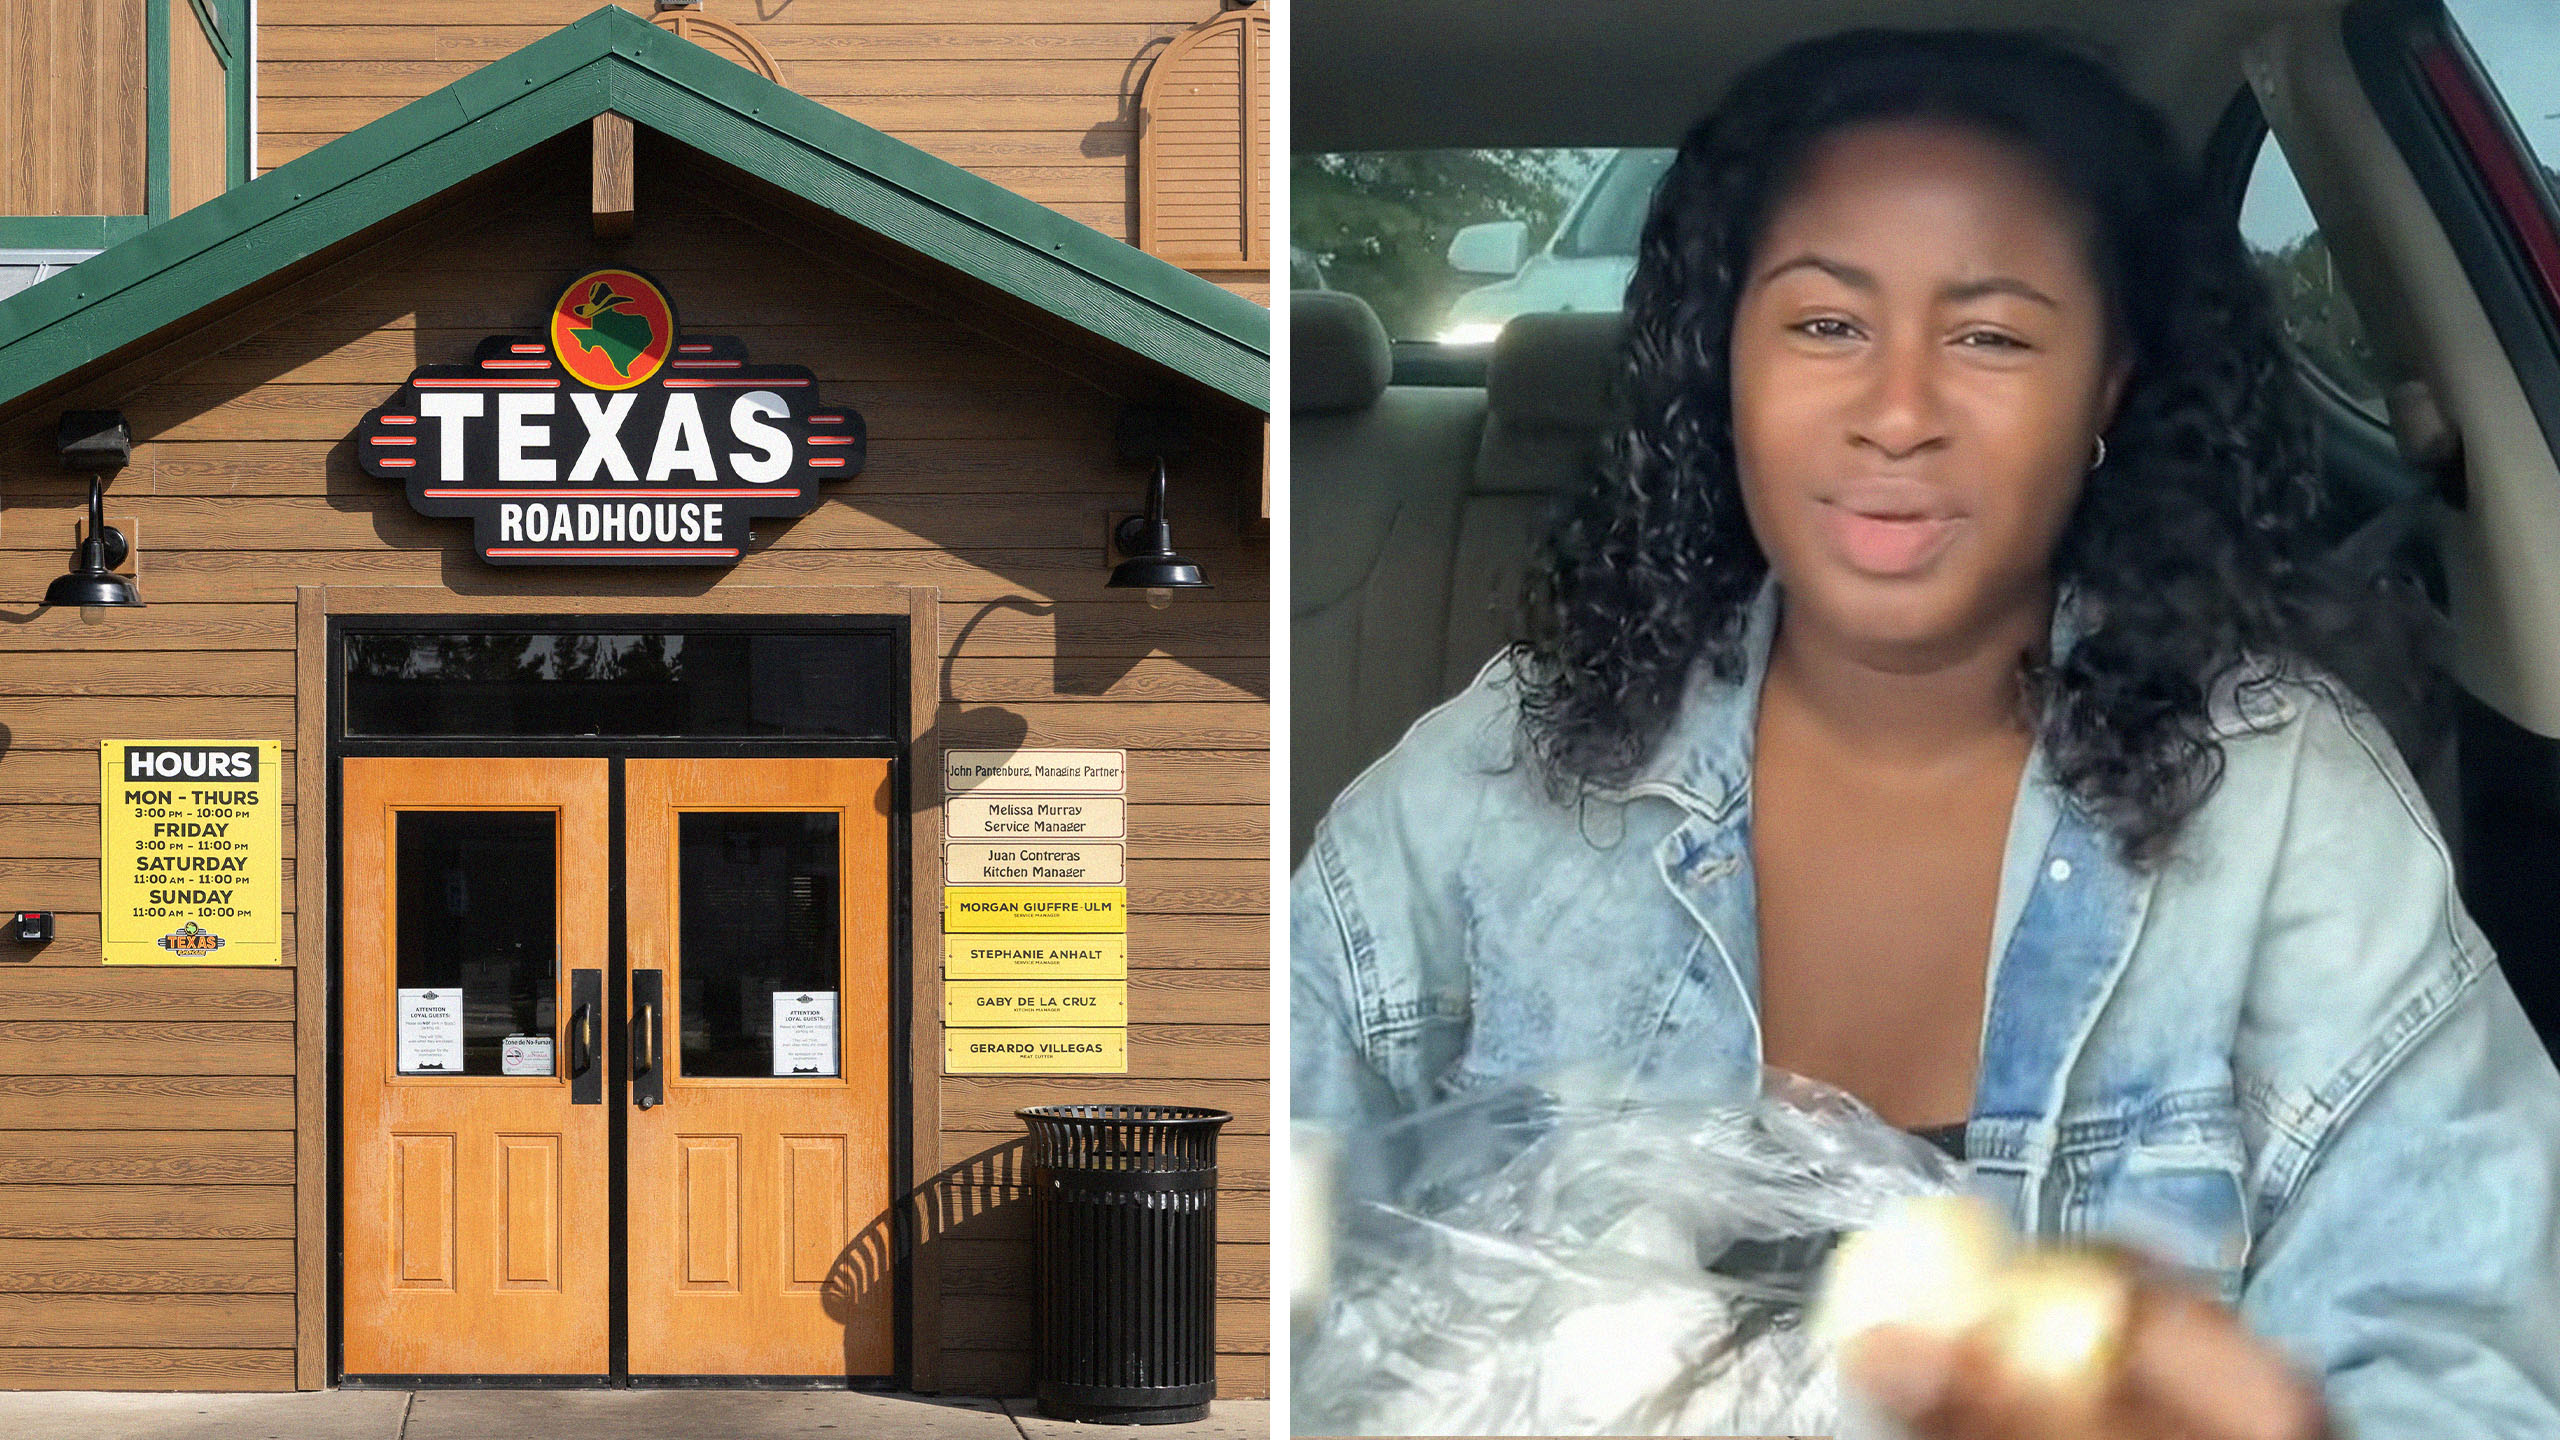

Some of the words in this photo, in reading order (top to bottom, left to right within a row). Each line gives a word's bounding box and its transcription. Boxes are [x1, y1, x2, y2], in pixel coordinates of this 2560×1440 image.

[420, 391, 794, 484] TEXAS
[500, 503, 723, 542] ROADHOUSE
[131, 751, 252, 778] HOURS
[950, 765, 972, 777] John
[975, 765, 1032, 777] Pantenburg,
[1035, 765, 1081, 777] Managing
[1084, 765, 1119, 777] Partner
[125, 790, 171, 805] MON
[191, 790, 259, 805] THURS
[135, 808, 165, 818] 3:00
[196, 808, 232, 818] 10:00
[989, 804, 1033, 816] Melissa
[1037, 804, 1082, 816] Murray
[154, 823, 229, 837] FRIDAY
[984, 821, 1030, 832] Service
[1034, 821, 1086, 832] Manager
[135, 841, 166, 850] 3:00
[198, 841, 231, 850] 11:00
[988, 850, 1016, 861] Juan
[1019, 850, 1080, 861] Contreras
[136, 856, 248, 871] SATURDAY
[983, 866, 1028, 878] Kitchen
[1032, 867, 1085, 878] Manager
[134, 874, 167, 884] 11:00
[199, 874, 232, 884] 11:00
[149, 890, 233, 904] SUNDAY
[133, 908, 166, 917] 11:00
[198, 908, 235, 917] 10:00
[960, 903, 1018, 912] MORGAN
[168, 936, 216, 949] TEXAS
[970, 950, 1044, 959] STEPHANIE
[1049, 950, 1102, 960] ANHALT
[976, 997, 1012, 1006] GABY
[1018, 997, 1035, 1006] DE
[1040, 998, 1057, 1006] LA
[1062, 997, 1097, 1007] CRUZ
[970, 1044, 1034, 1053] GERARDO
[1039, 1044, 1102, 1053] VILLEGAS
